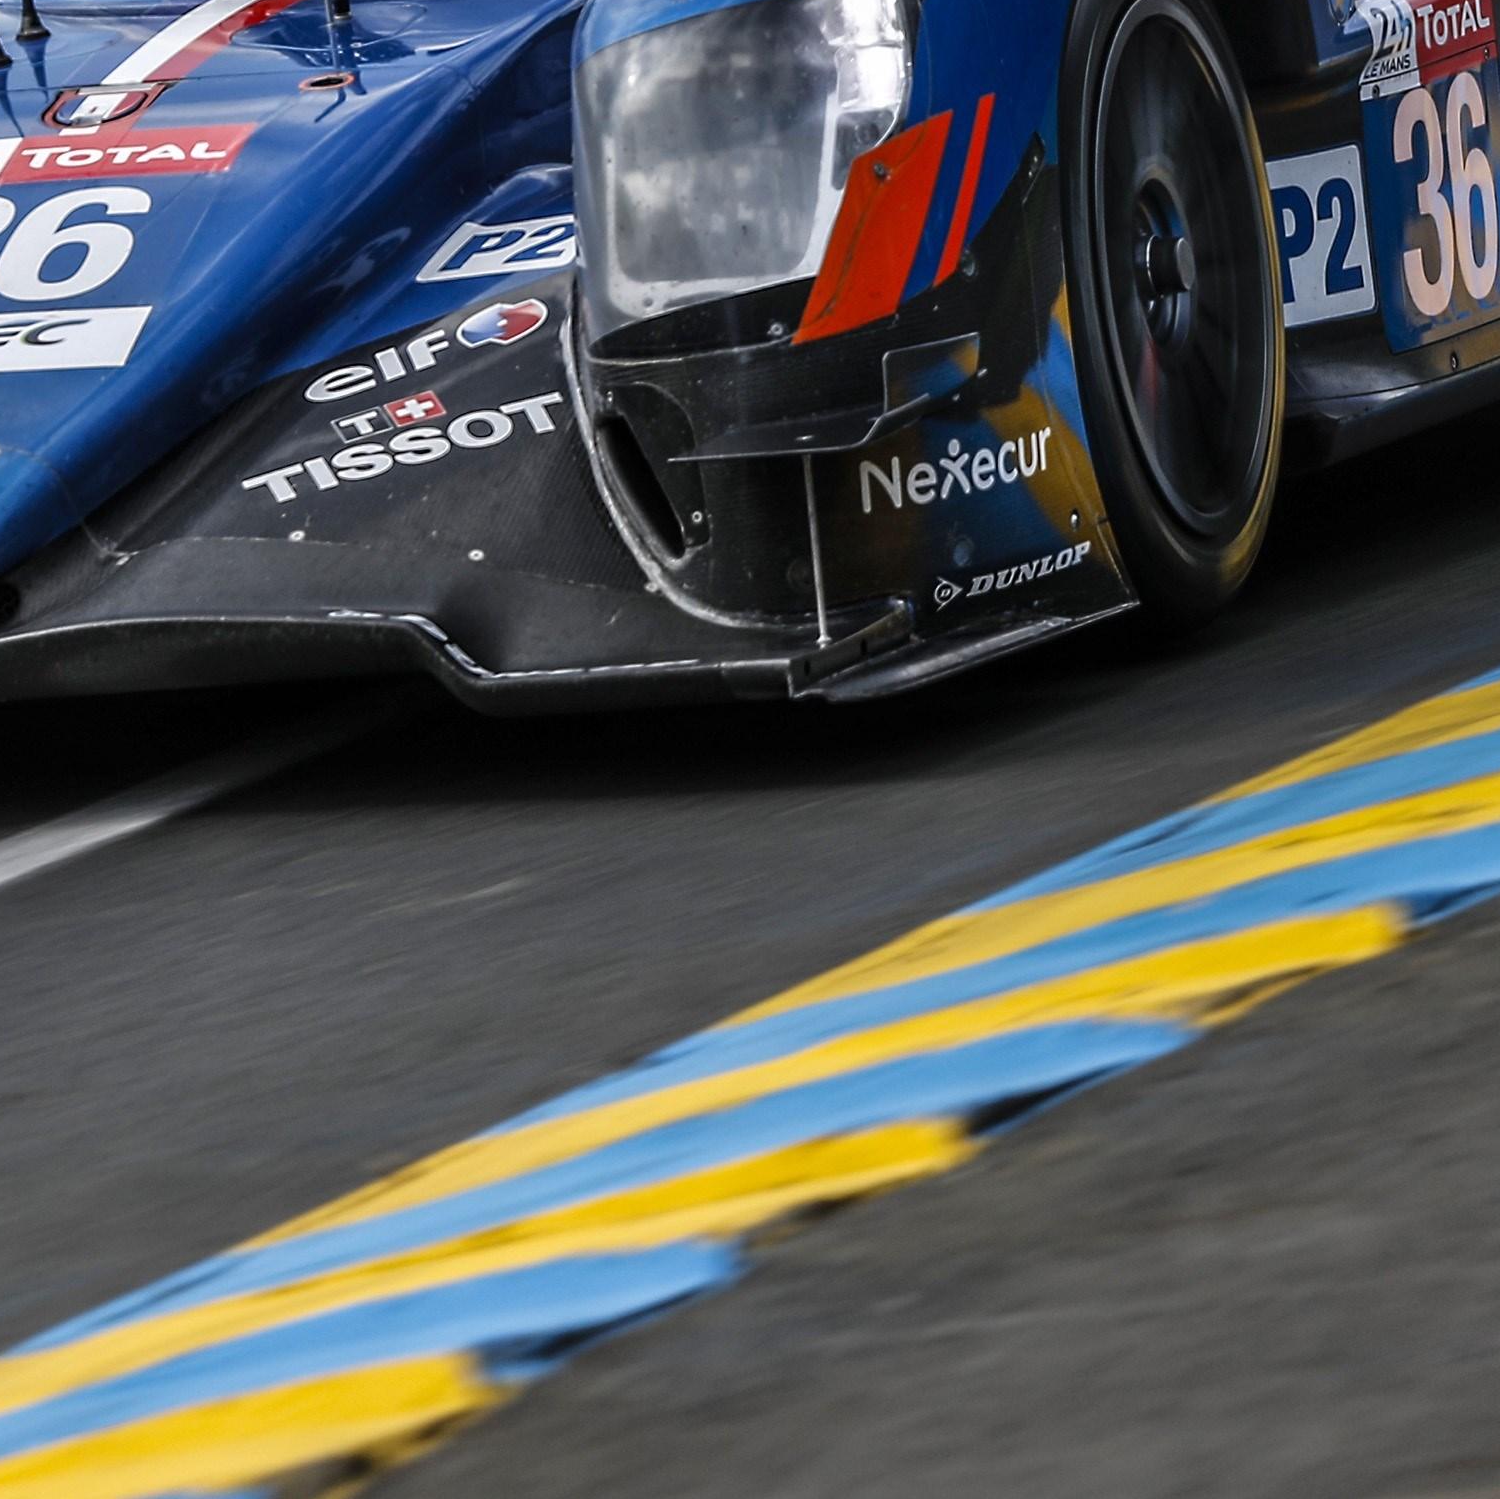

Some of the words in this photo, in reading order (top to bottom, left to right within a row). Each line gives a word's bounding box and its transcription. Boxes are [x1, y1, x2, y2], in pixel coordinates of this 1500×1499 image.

[1363, 60, 1381, 79] LE
[1380, 53, 1411, 76] MANS
[20, 140, 229, 170] TOTAL
[1392, 71, 1500, 317] 36
[439, 221, 577, 271] P2
[1270, 183, 1366, 303] P2
[304, 329, 450, 404] elf
[240, 391, 564, 504] TISSOT
[859, 426, 1052, 514] Nexecur
[965, 540, 1092, 598] DUNLOP
